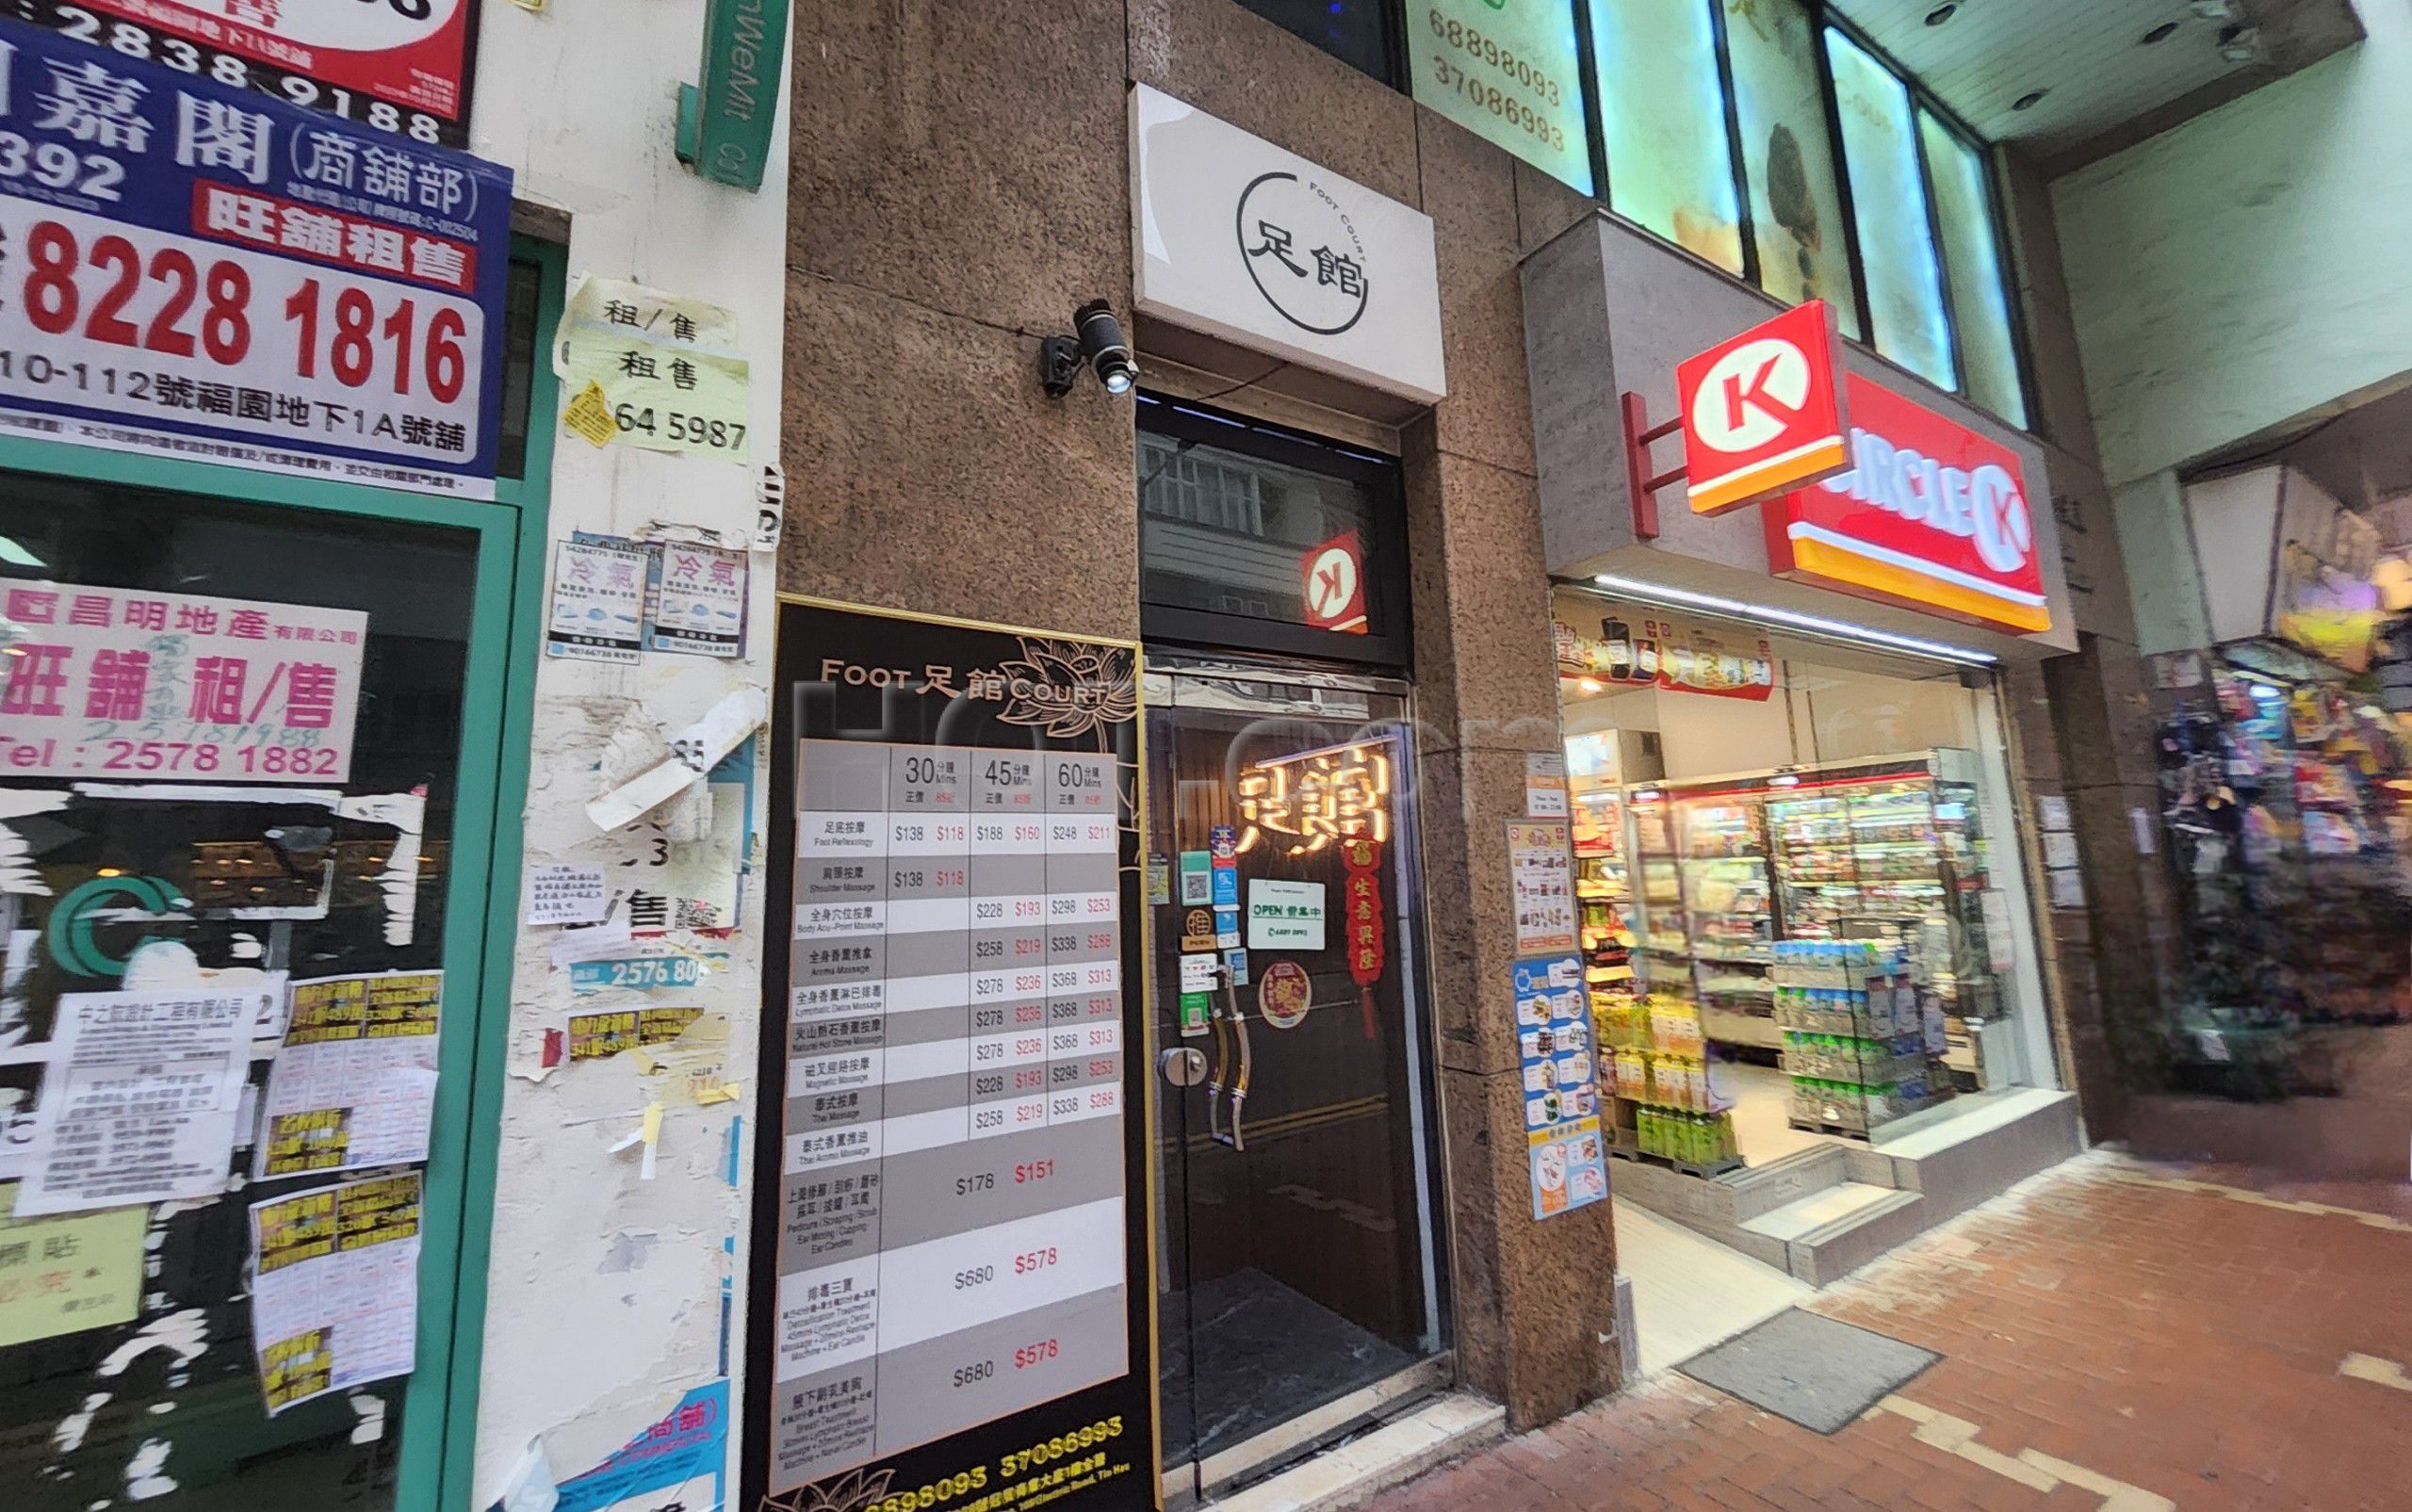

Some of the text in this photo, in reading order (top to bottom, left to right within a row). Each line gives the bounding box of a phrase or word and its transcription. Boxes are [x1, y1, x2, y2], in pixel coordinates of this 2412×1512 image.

[1429, 8, 1559, 107] 68898093
[54, 6, 248, 89] 2838
[282, 75, 440, 144] 9188
[0, 38, 274, 187] 嘉閣
[1433, 55, 1565, 152] 37086993
[205, 187, 464, 286] 旺舖租售
[1309, 181, 1368, 263] FOOT COURT
[1247, 219, 1362, 299] 足館
[24, 219, 466, 404] 8228 1816
[619, 349, 698, 391] 租售
[667, 411, 747, 451] 5987
[1820, 427, 1975, 537] IRCLE
[821, 658, 912, 690] FOOT
[915, 664, 1007, 702] 足館
[1009, 677, 1111, 705] COURT
[101, 740, 220, 772] 2578
[237, 743, 338, 775] 1882
[905, 756, 935, 784] 30
[985, 760, 1013, 788] 45
[1057, 762, 1084, 788] 60
[895, 824, 1112, 842] $138 $118 $188 $160 $248 $211
[895, 870, 964, 888] $138 $118
[976, 902, 1003, 919] $228
[1051, 897, 1078, 916] $298
[1253, 904, 1283, 916] OPEN
[976, 939, 1003, 958] $258
[1051, 935, 1078, 953] $338
[612, 962, 668, 984] 2576
[976, 977, 1003, 996] $278
[1051, 970, 1078, 989] $368
[976, 1009, 1003, 1028] $278
[1051, 1001, 1078, 1020] $368
[976, 1041, 1003, 1061] $278
[1051, 1032, 1078, 1051] $368
[976, 1075, 1003, 1095] $228
[1051, 1065, 1078, 1084] $298
[976, 1110, 1003, 1130] $258
[1051, 1097, 1078, 1116] $338
[954, 1159, 1055, 1196] $178 $151
[953, 1247, 1058, 1291] $680 $578
[953, 1339, 1060, 1389] $680 $578
